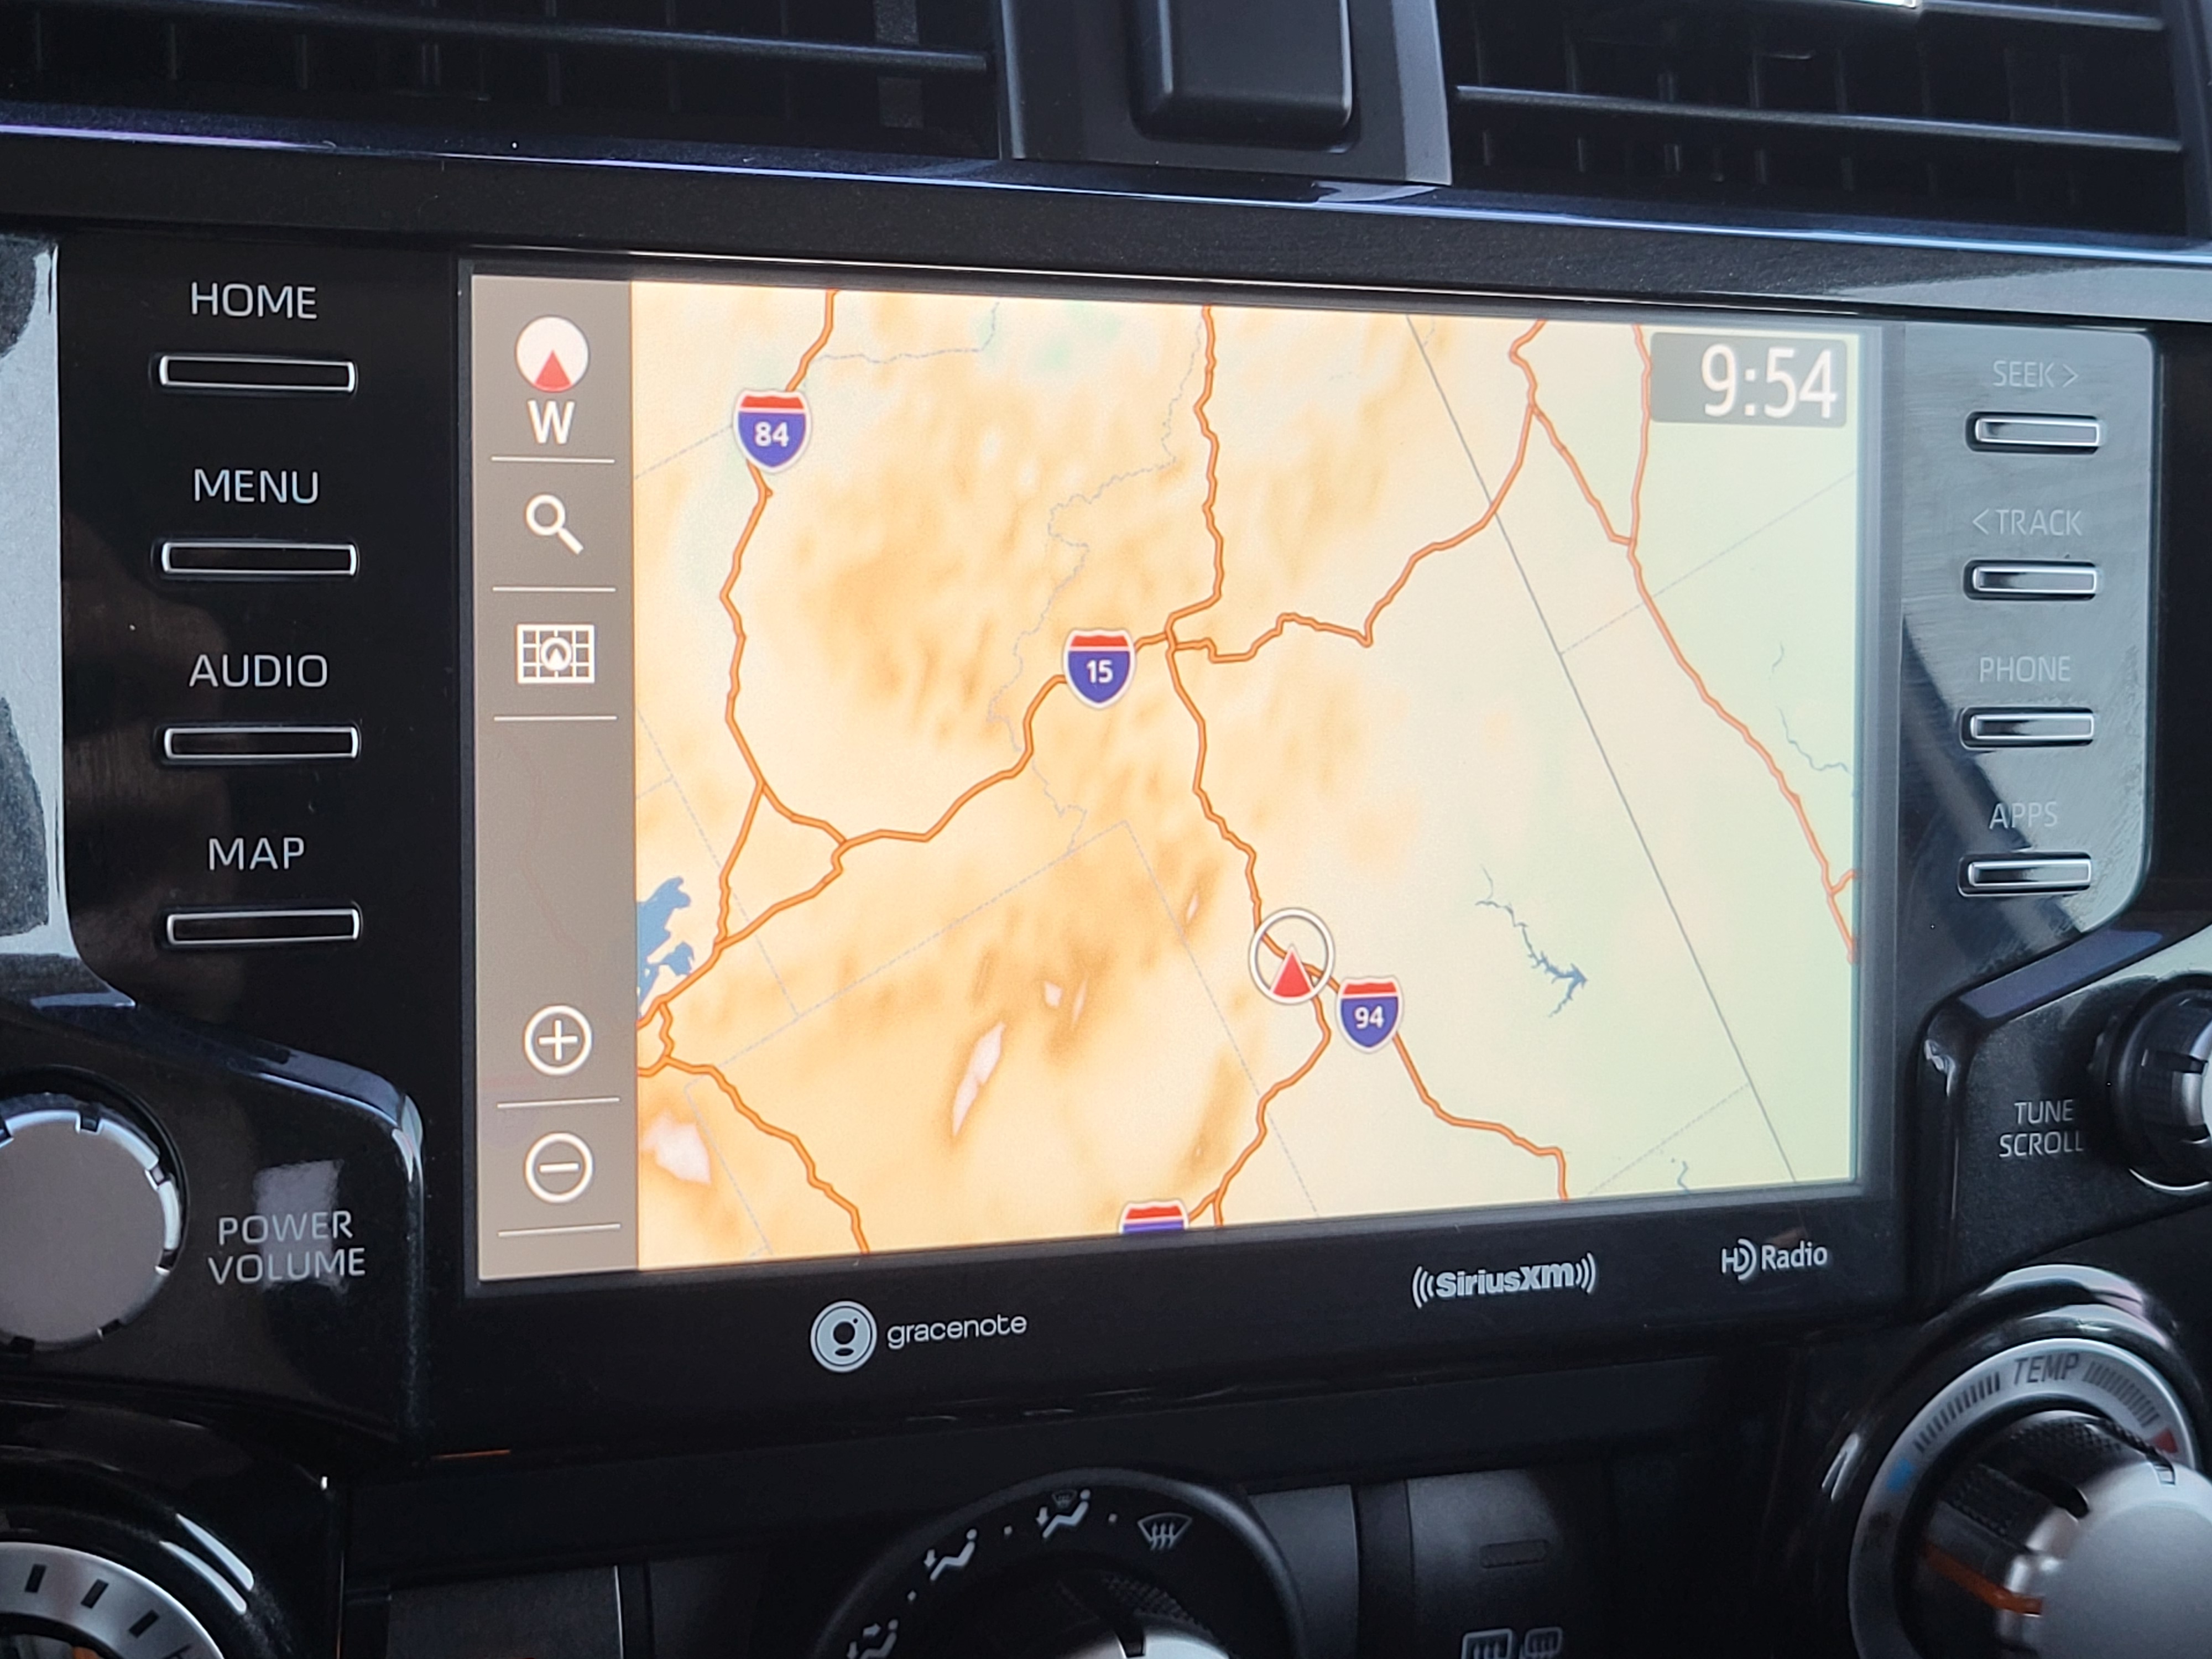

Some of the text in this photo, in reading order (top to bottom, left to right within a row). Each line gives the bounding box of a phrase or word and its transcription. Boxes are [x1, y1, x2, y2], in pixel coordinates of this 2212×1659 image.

[191, 281, 317, 319] HOME
[1701, 343, 1837, 419] 9:54
[1992, 360, 2054, 387] SEEK
[527, 399, 575, 444] W
[754, 421, 789, 448] 84
[194, 468, 319, 504] MENU
[1996, 509, 2082, 536] TRACK
[189, 654, 328, 688] AUDIO
[1086, 659, 1114, 684] 15
[1979, 655, 2071, 682] PHONE
[1989, 801, 2058, 830] APPS
[208, 837, 305, 870] MAP
[1354, 1005, 1385, 1030] 94
[2015, 1099, 2075, 1125] TUNE
[1999, 1131, 2085, 1158] SCROLL
[218, 1209, 354, 1245] POWER
[208, 1248, 366, 1285] VOLUME
[1721, 1240, 1828, 1278] HD Radio
[886, 1313, 1027, 1349] gracenote
[2013, 1353, 2079, 1385] TEMP
